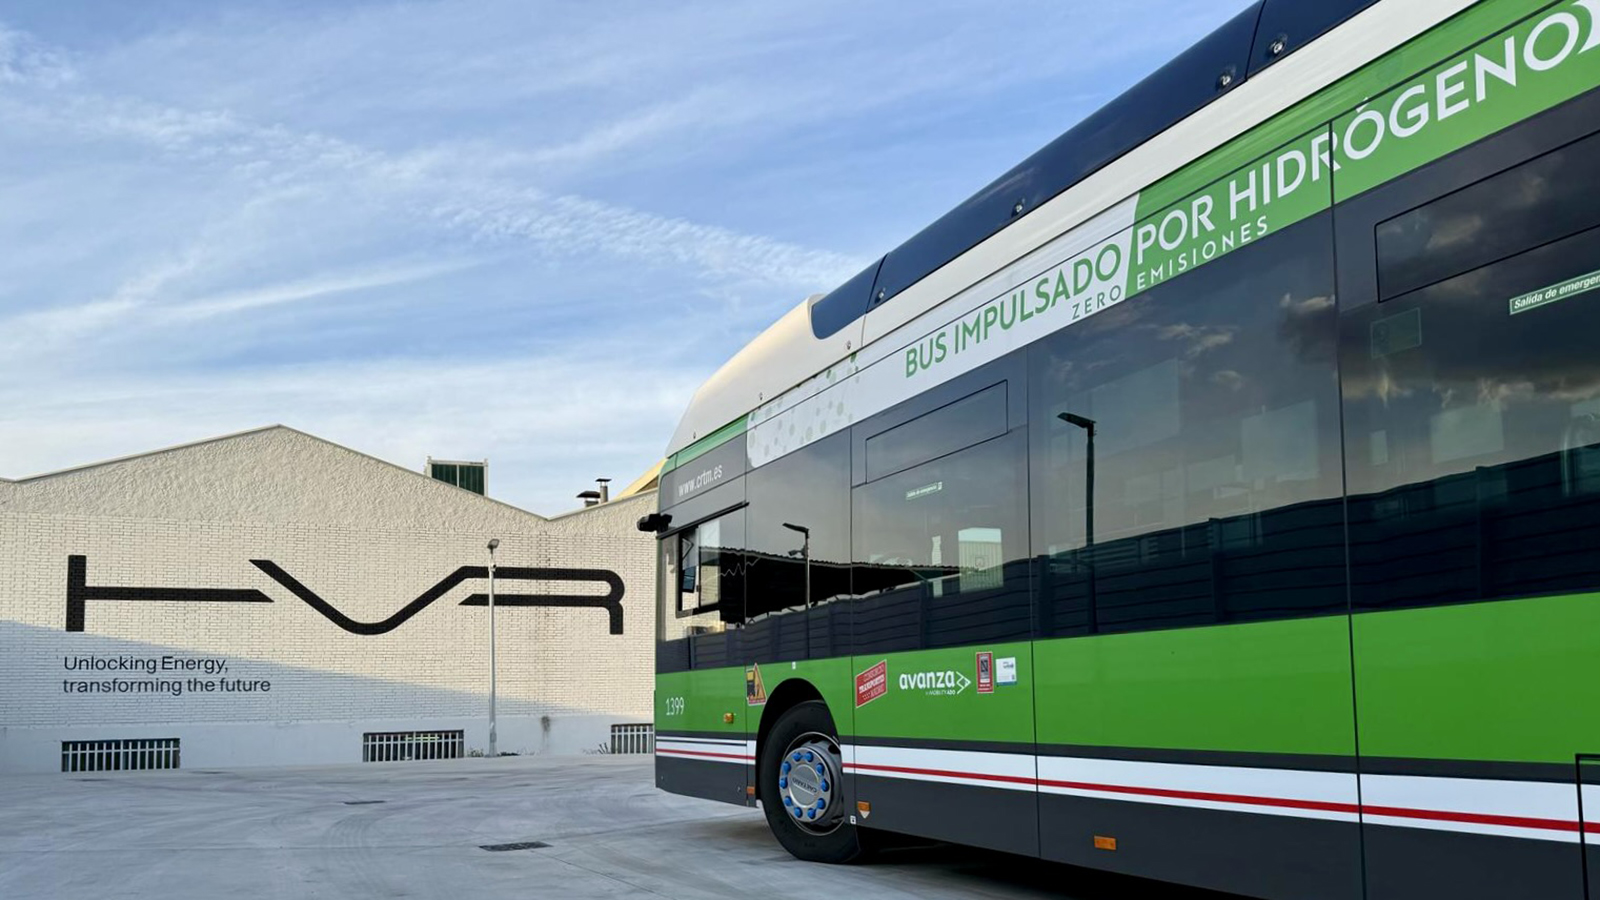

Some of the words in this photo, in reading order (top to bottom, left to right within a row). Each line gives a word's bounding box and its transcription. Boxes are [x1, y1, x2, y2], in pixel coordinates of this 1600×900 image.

[905, 331, 947, 378] BUS
[954, 243, 1121, 355] IMPULSADO
[1136, 194, 1215, 265] POR
[1229, 12, 1580, 221] HIDRÓGENO
[1072, 284, 1122, 320] ZERO
[1136, 215, 1268, 290] EMISIONES
[1514, 293, 1542, 309] Salida
[1545, 288, 1557, 299] de
[678, 464, 723, 497] www.crtm.es
[63, 656, 157, 674] Unlocking
[161, 656, 229, 674] Energy,
[63, 677, 182, 696] transforming
[187, 678, 216, 692] the
[219, 677, 271, 692] future
[899, 670, 956, 690] avanza
[665, 697, 685, 716] 1399
